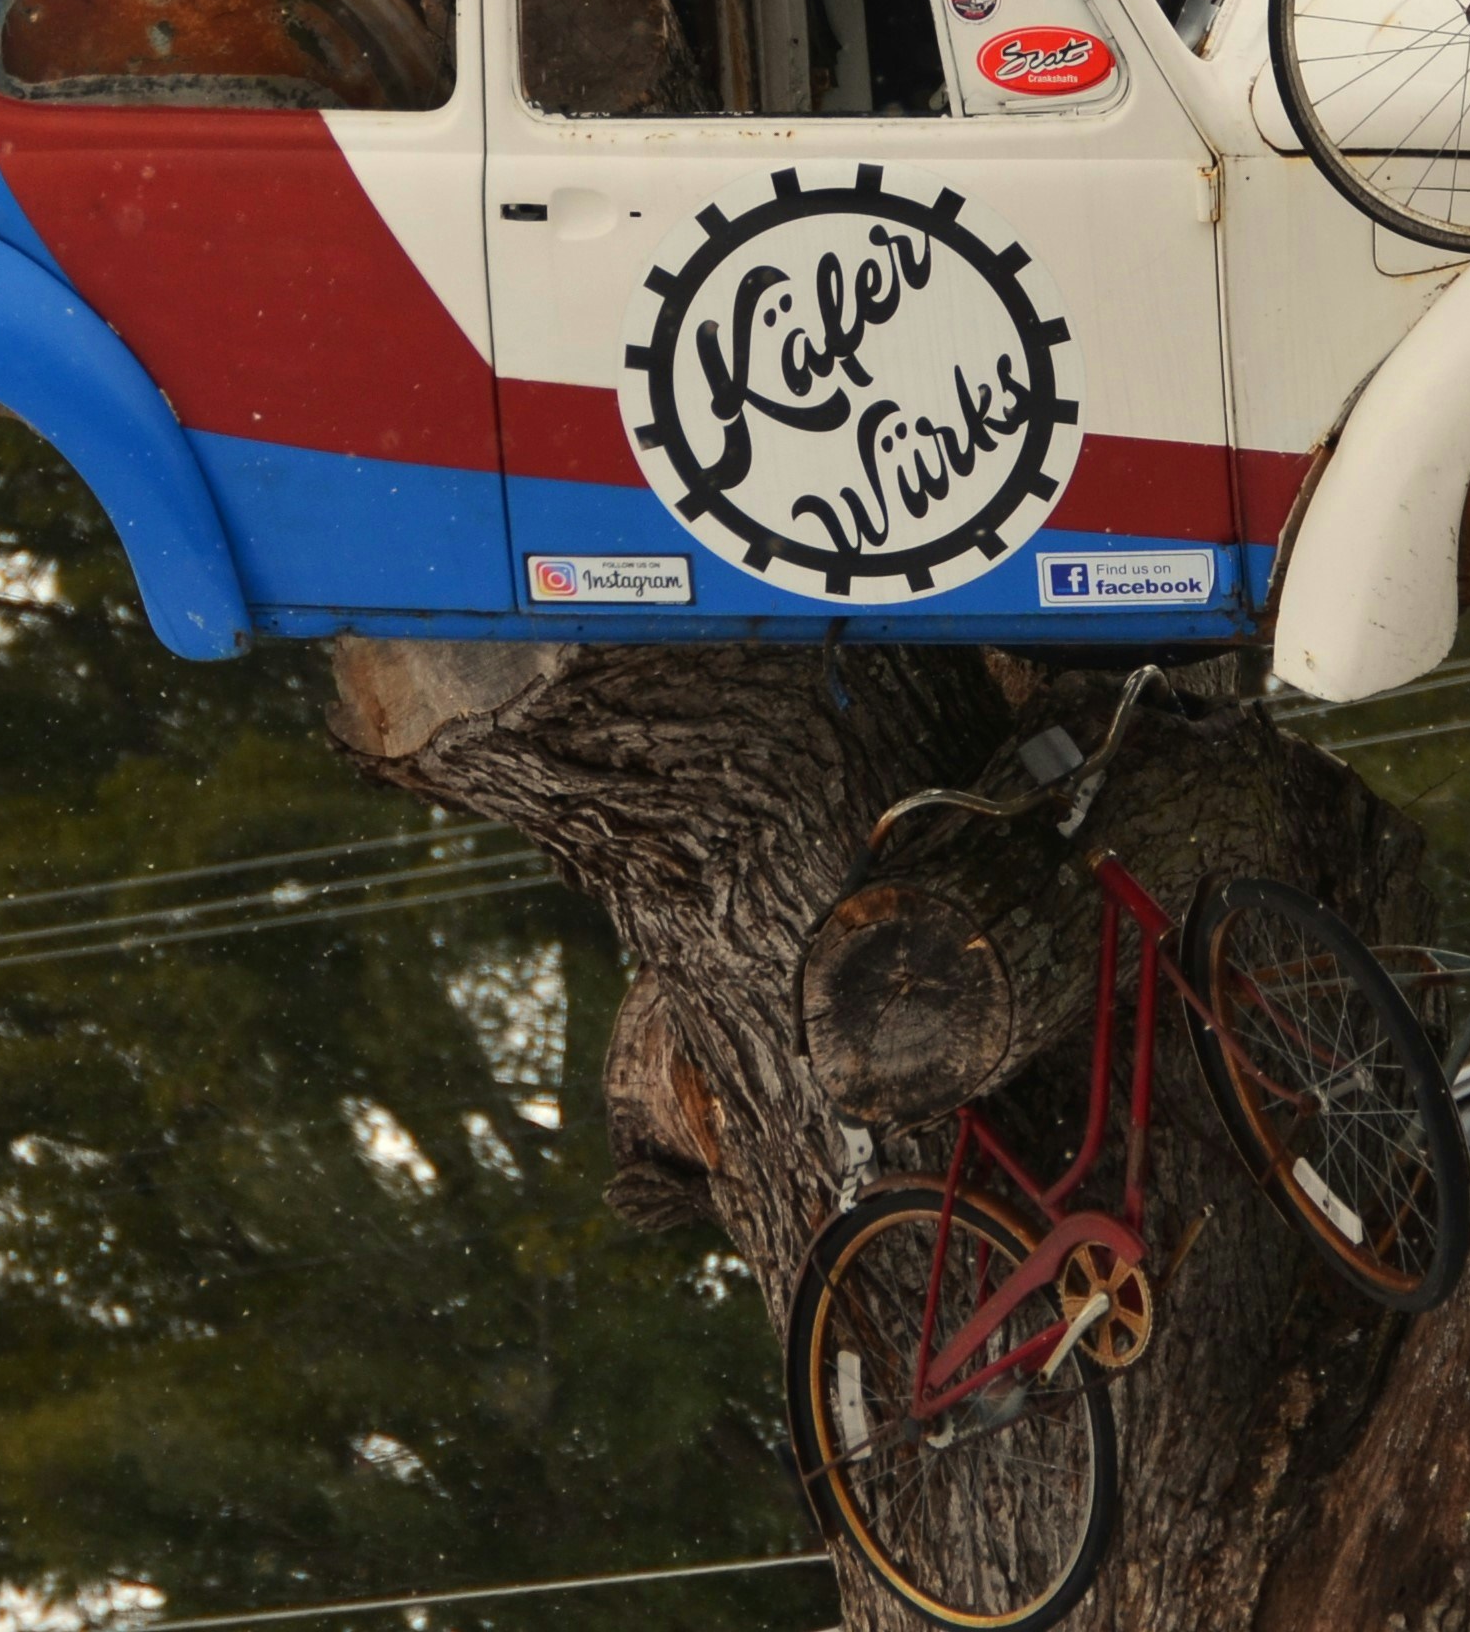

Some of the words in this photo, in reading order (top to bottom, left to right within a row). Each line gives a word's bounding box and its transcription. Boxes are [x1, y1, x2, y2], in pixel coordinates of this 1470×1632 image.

[1027, 73, 1079, 84] Crankshafts
[695, 223, 932, 490] Käfer
[790, 352, 1031, 555] Würks
[602, 561, 635, 569] FOLLOW
[1096, 563, 1128, 576] Find
[1132, 564, 1149, 575] us
[1153, 564, 1172, 575] on
[582, 569, 683, 598] Instagram
[1096, 577, 1203, 596] facebook
